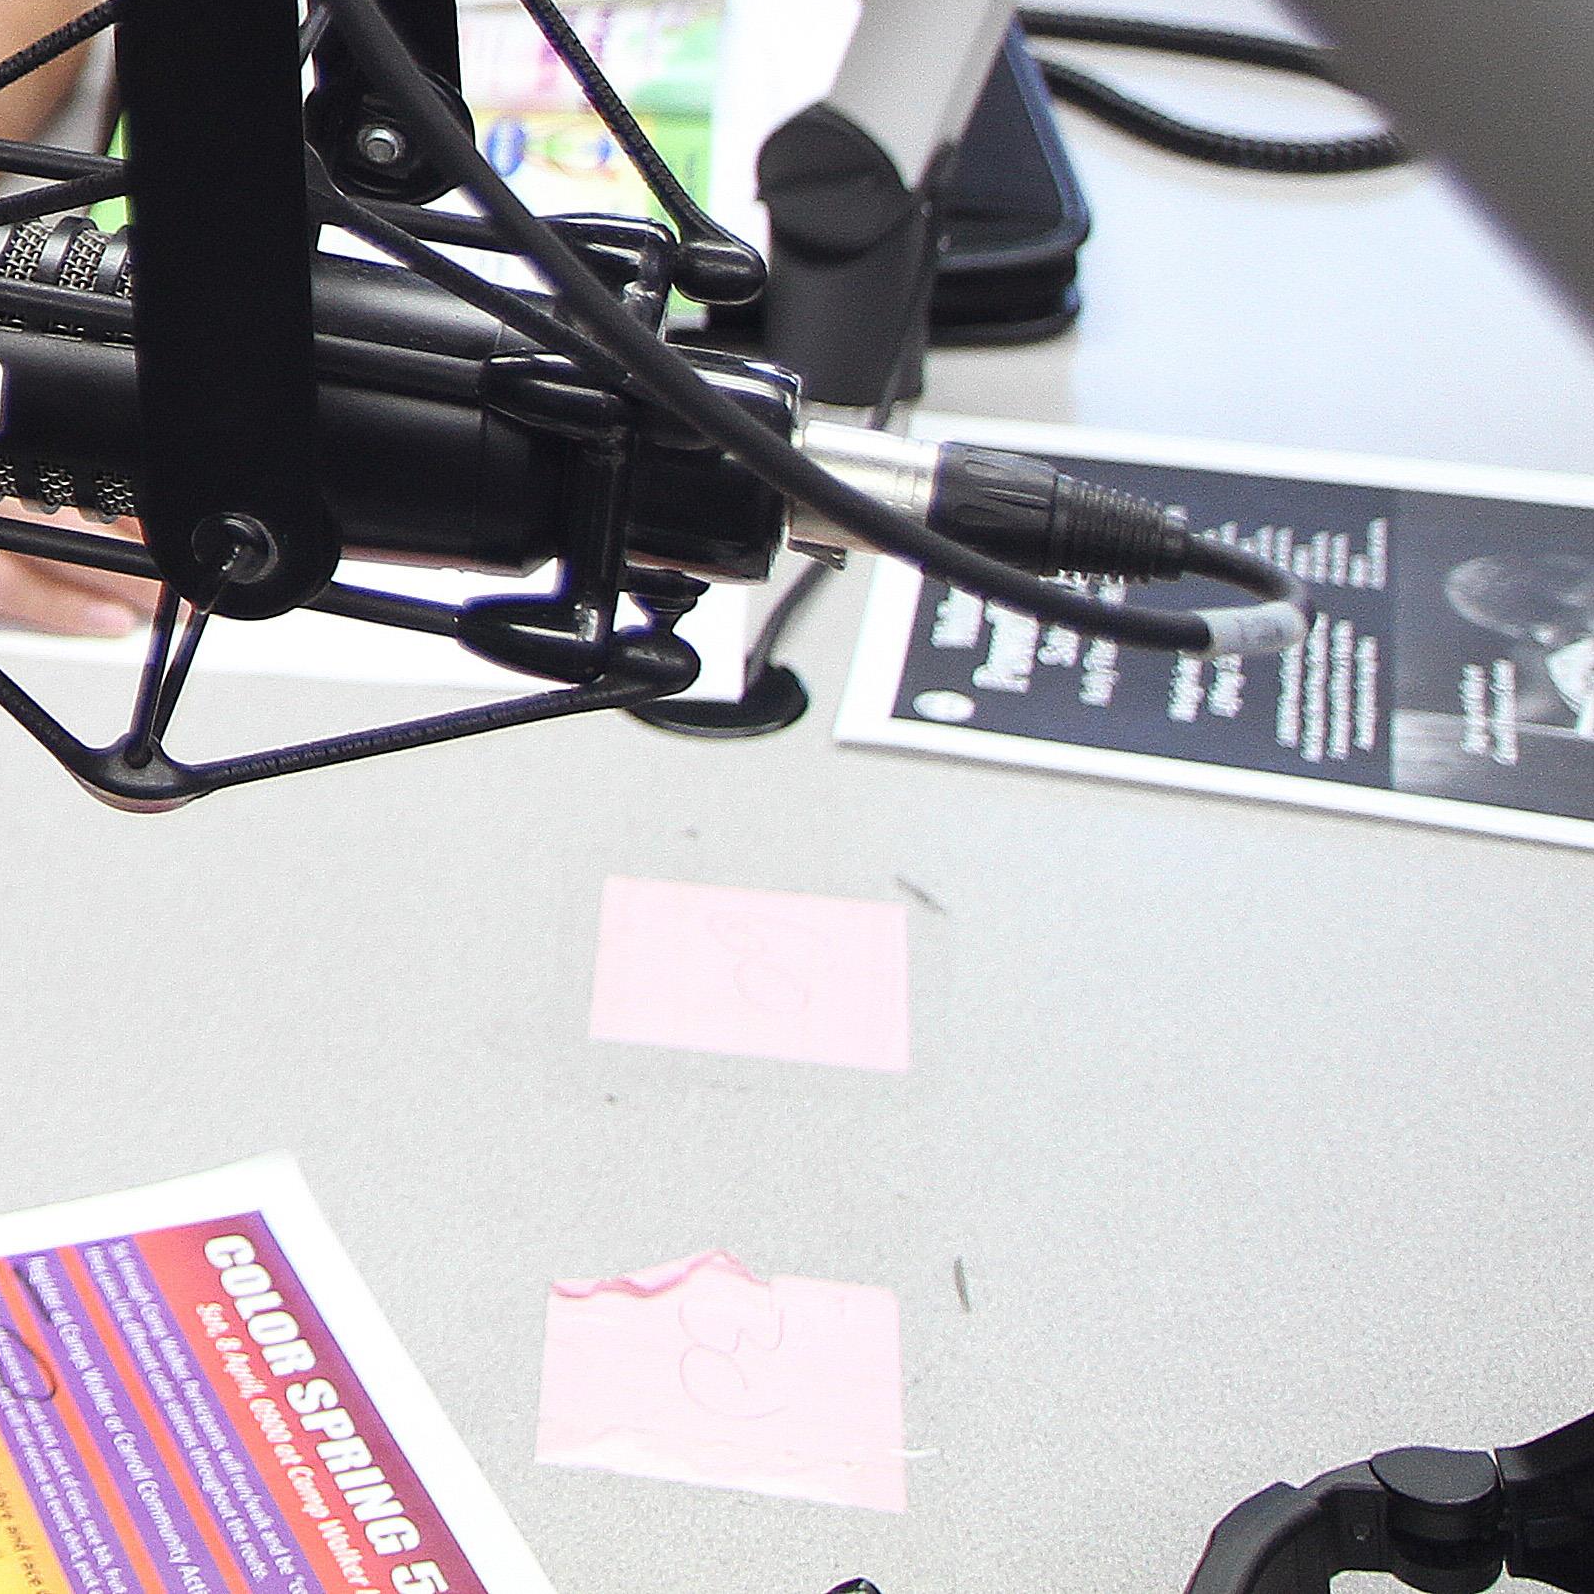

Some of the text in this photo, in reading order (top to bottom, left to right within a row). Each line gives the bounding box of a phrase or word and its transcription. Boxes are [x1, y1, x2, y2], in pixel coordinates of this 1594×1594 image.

[204, 1234, 316, 1377] COLOR
[285, 1377, 421, 1556] SPRING
[273, 1443, 304, 1467] at
[112, 1432, 154, 1481] Carroll
[136, 1479, 191, 1564] Community
[190, 1447, 238, 1519] throughout
[225, 1517, 249, 1542] the
[287, 1465, 330, 1519] Camp
[260, 1530, 290, 1556] and
[275, 1555, 294, 1575] be
[317, 1518, 372, 1587] Walker
